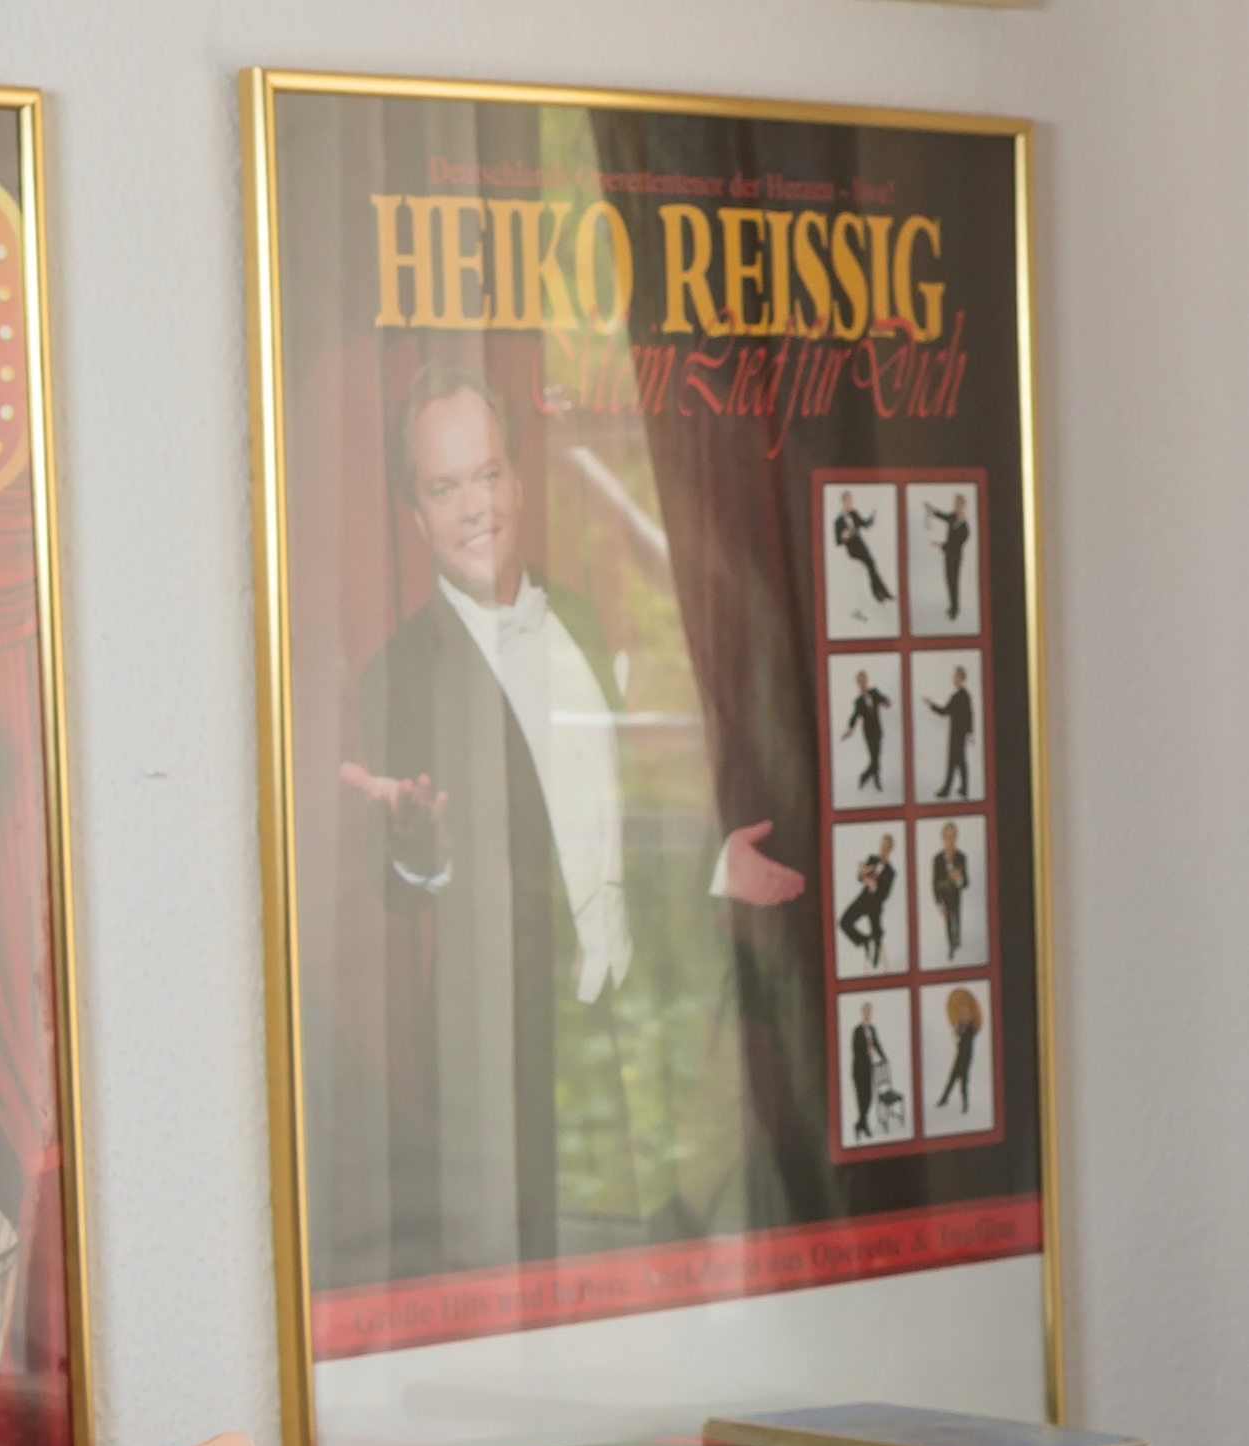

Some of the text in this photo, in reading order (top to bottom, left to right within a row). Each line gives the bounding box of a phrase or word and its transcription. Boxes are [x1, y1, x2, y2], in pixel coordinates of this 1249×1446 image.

[371, 193, 946, 343] HEIKO REISSIG
[852, 308, 968, 419] Dich
